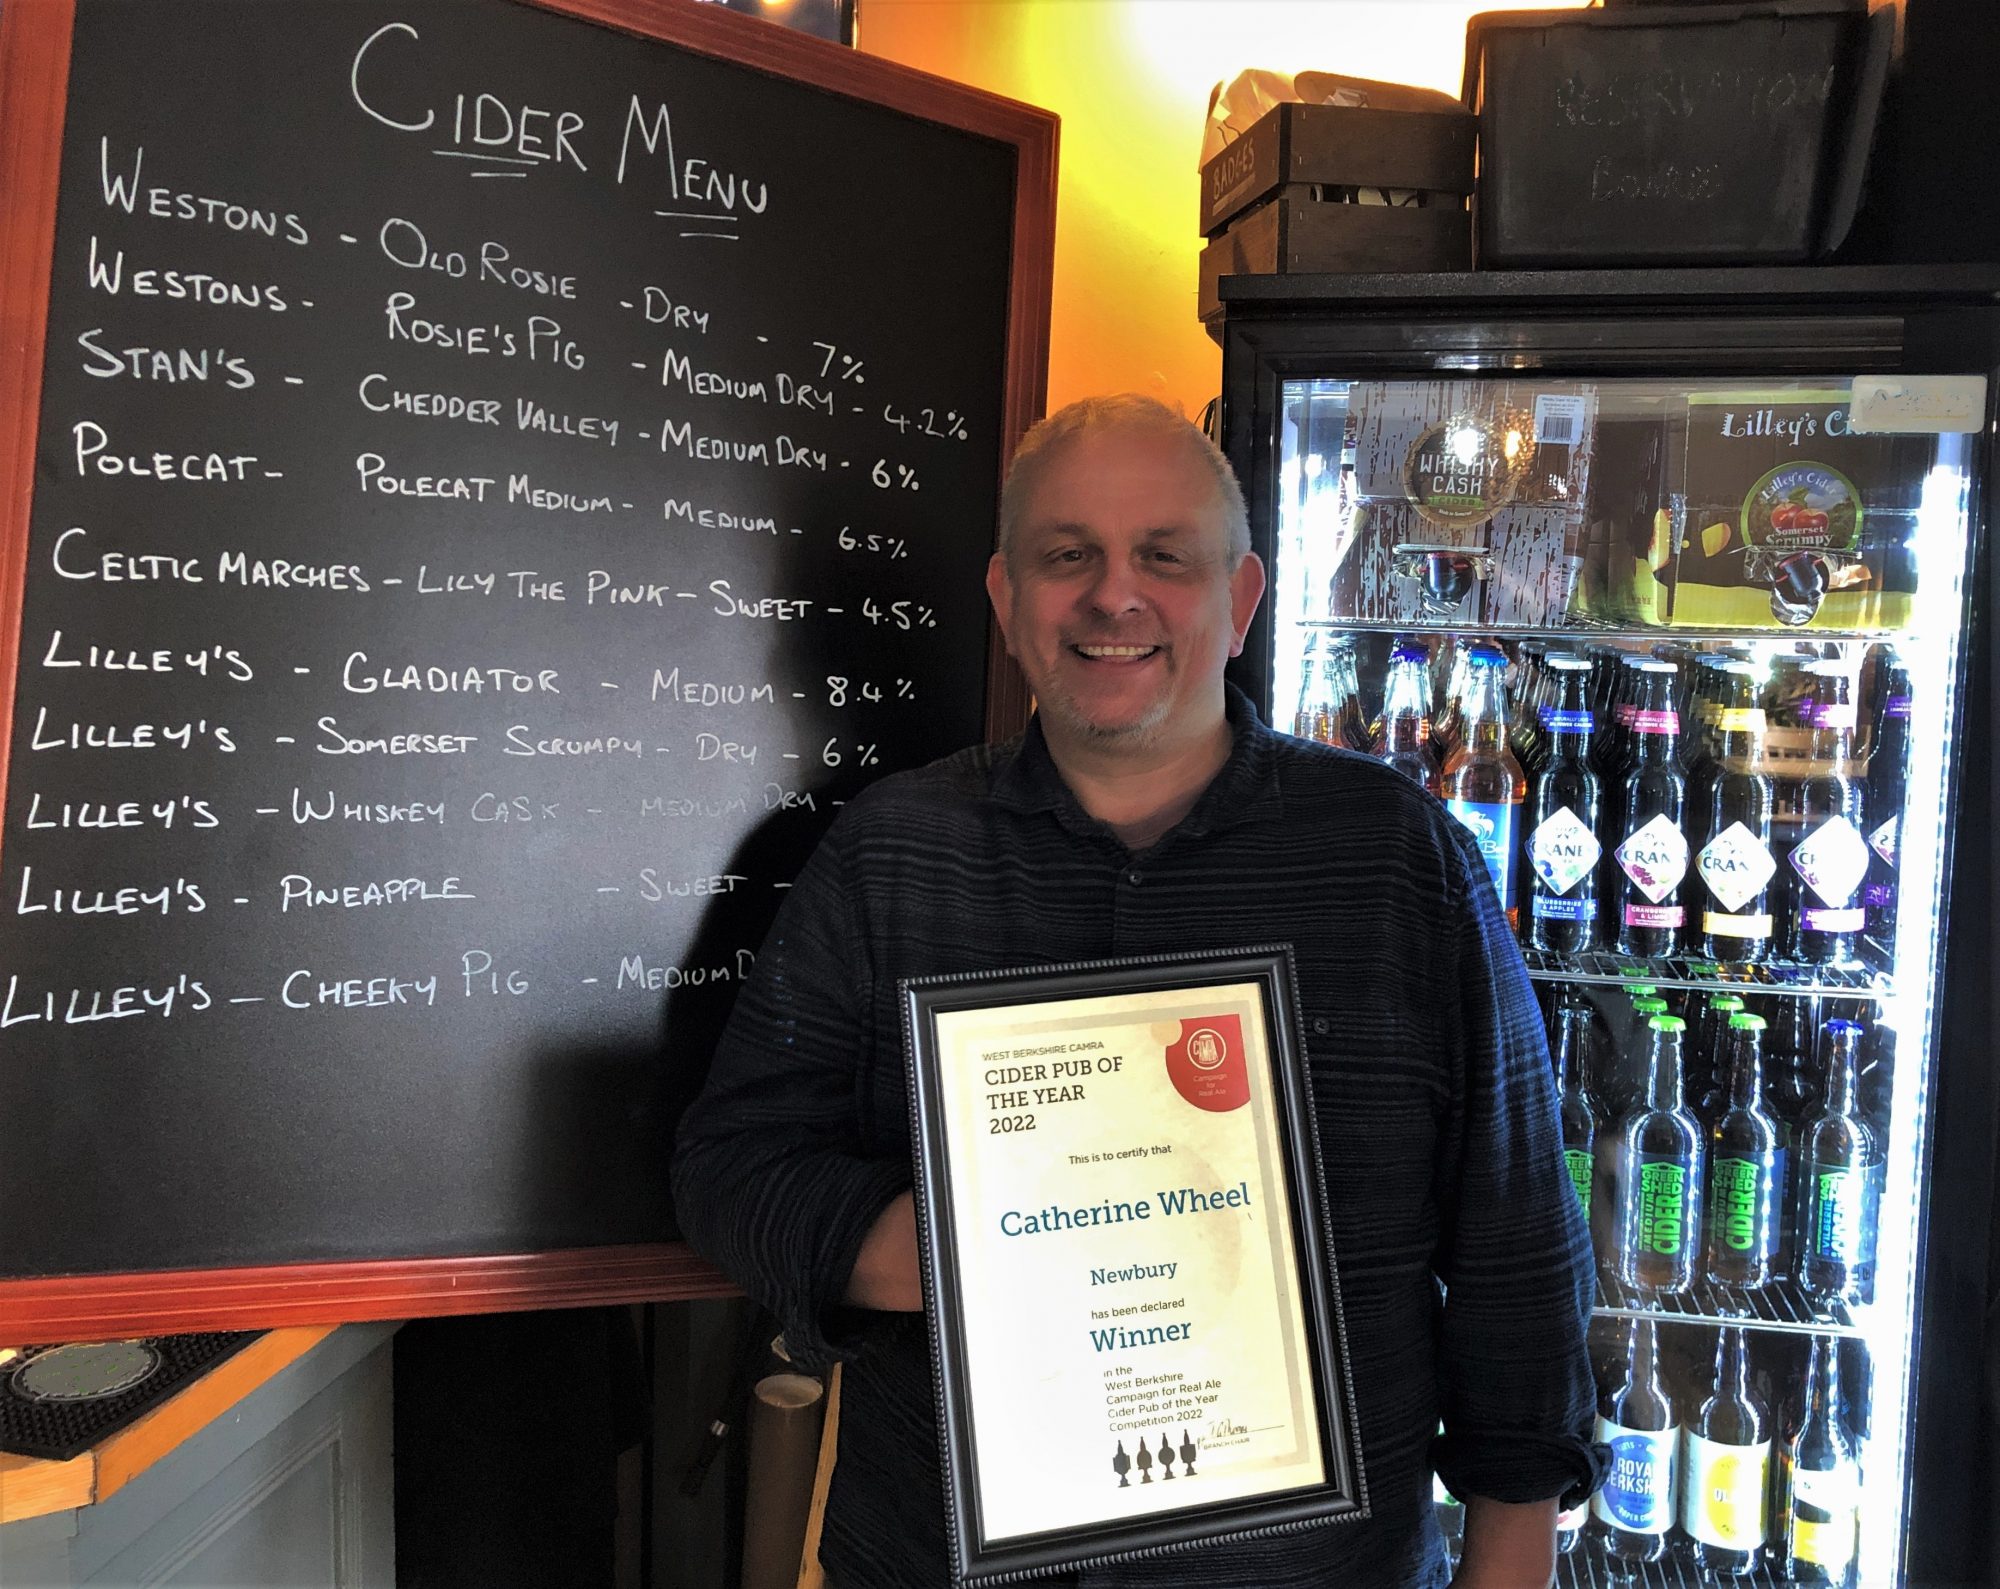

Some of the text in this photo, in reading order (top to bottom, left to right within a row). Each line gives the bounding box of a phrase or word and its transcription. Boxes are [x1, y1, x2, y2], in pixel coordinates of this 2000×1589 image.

[351, 23, 767, 214] CIDER MENU
[102, 136, 865, 384] WESTONS OLD ROSIE DRY 7%
[89, 236, 967, 441] WESTONS ROSIE'S PIG MEDIUM DRY 4.2%
[78, 329, 920, 491] STAN'S CHEDDER VALLEY MEDIUM DRY 6%
[1720, 410, 1817, 447] Lilley's
[73, 421, 907, 559] POLECAT POLECAT MEDIUM MEDIUM 6.5%
[1432, 475, 1483, 495] CASK
[1762, 472, 1837, 500] Lilley's Cider
[1766, 534, 1834, 546] Scrumpy
[1775, 526, 1824, 536] Somerset
[53, 528, 937, 630] CELTIC MARCHES LILY THE PINK SWEET 4.5%
[42, 630, 253, 682] LILLEY'S
[343, 651, 561, 694] GLADIATOR
[651, 668, 774, 706] MEDIUM
[31, 707, 237, 753] LILLEY'S
[316, 716, 478, 755] SOMERSET
[504, 725, 642, 758] SCRUMPY
[696, 732, 756, 765] DRY
[26, 783, 817, 830] LILLEY'S WHISKEY CASK MEDIUM DRY
[1623, 850, 1671, 865] CRAN
[17, 866, 748, 915] LILLEY'S PINEAPPLE SWEET
[0, 973, 212, 1028] LILLEY'S
[281, 969, 437, 1010] CHEEKY
[461, 949, 529, 997] PIG
[617, 955, 731, 991] MEDIUM
[982, 1041, 1105, 1061] WEST BERKSHIRE CAMRA
[985, 1056, 1124, 1086] CIDER PUB OF
[986, 1084, 1086, 1110] THE YEAR
[989, 1114, 1037, 1135] 2022
[1068, 1144, 1172, 1166] This is to certify that
[1642, 1170, 1684, 1184] GREEN
[1714, 1166, 1757, 1180] GREEN
[1715, 1176, 1757, 1190] SHED
[1641, 1181, 1683, 1194] SHED
[1000, 1182, 1252, 1237] Catherine Wheel
[1643, 1193, 1655, 1245] MEDIUM
[1725, 1190, 1756, 1250] CIDER
[1652, 1194, 1683, 1254] CIDER
[1090, 1262, 1178, 1286] Newbury
[1091, 1298, 1185, 1320] has been declared
[1090, 1321, 1192, 1353] Winner
[1103, 1365, 1133, 1379] in the
[1105, 1371, 1184, 1392] West Berkshire
[1106, 1379, 1222, 1406] Campaign for Real Ale
[1108, 1393, 1219, 1419] Cider Pub of the Year
[1109, 1408, 1203, 1433] Competition 2022
